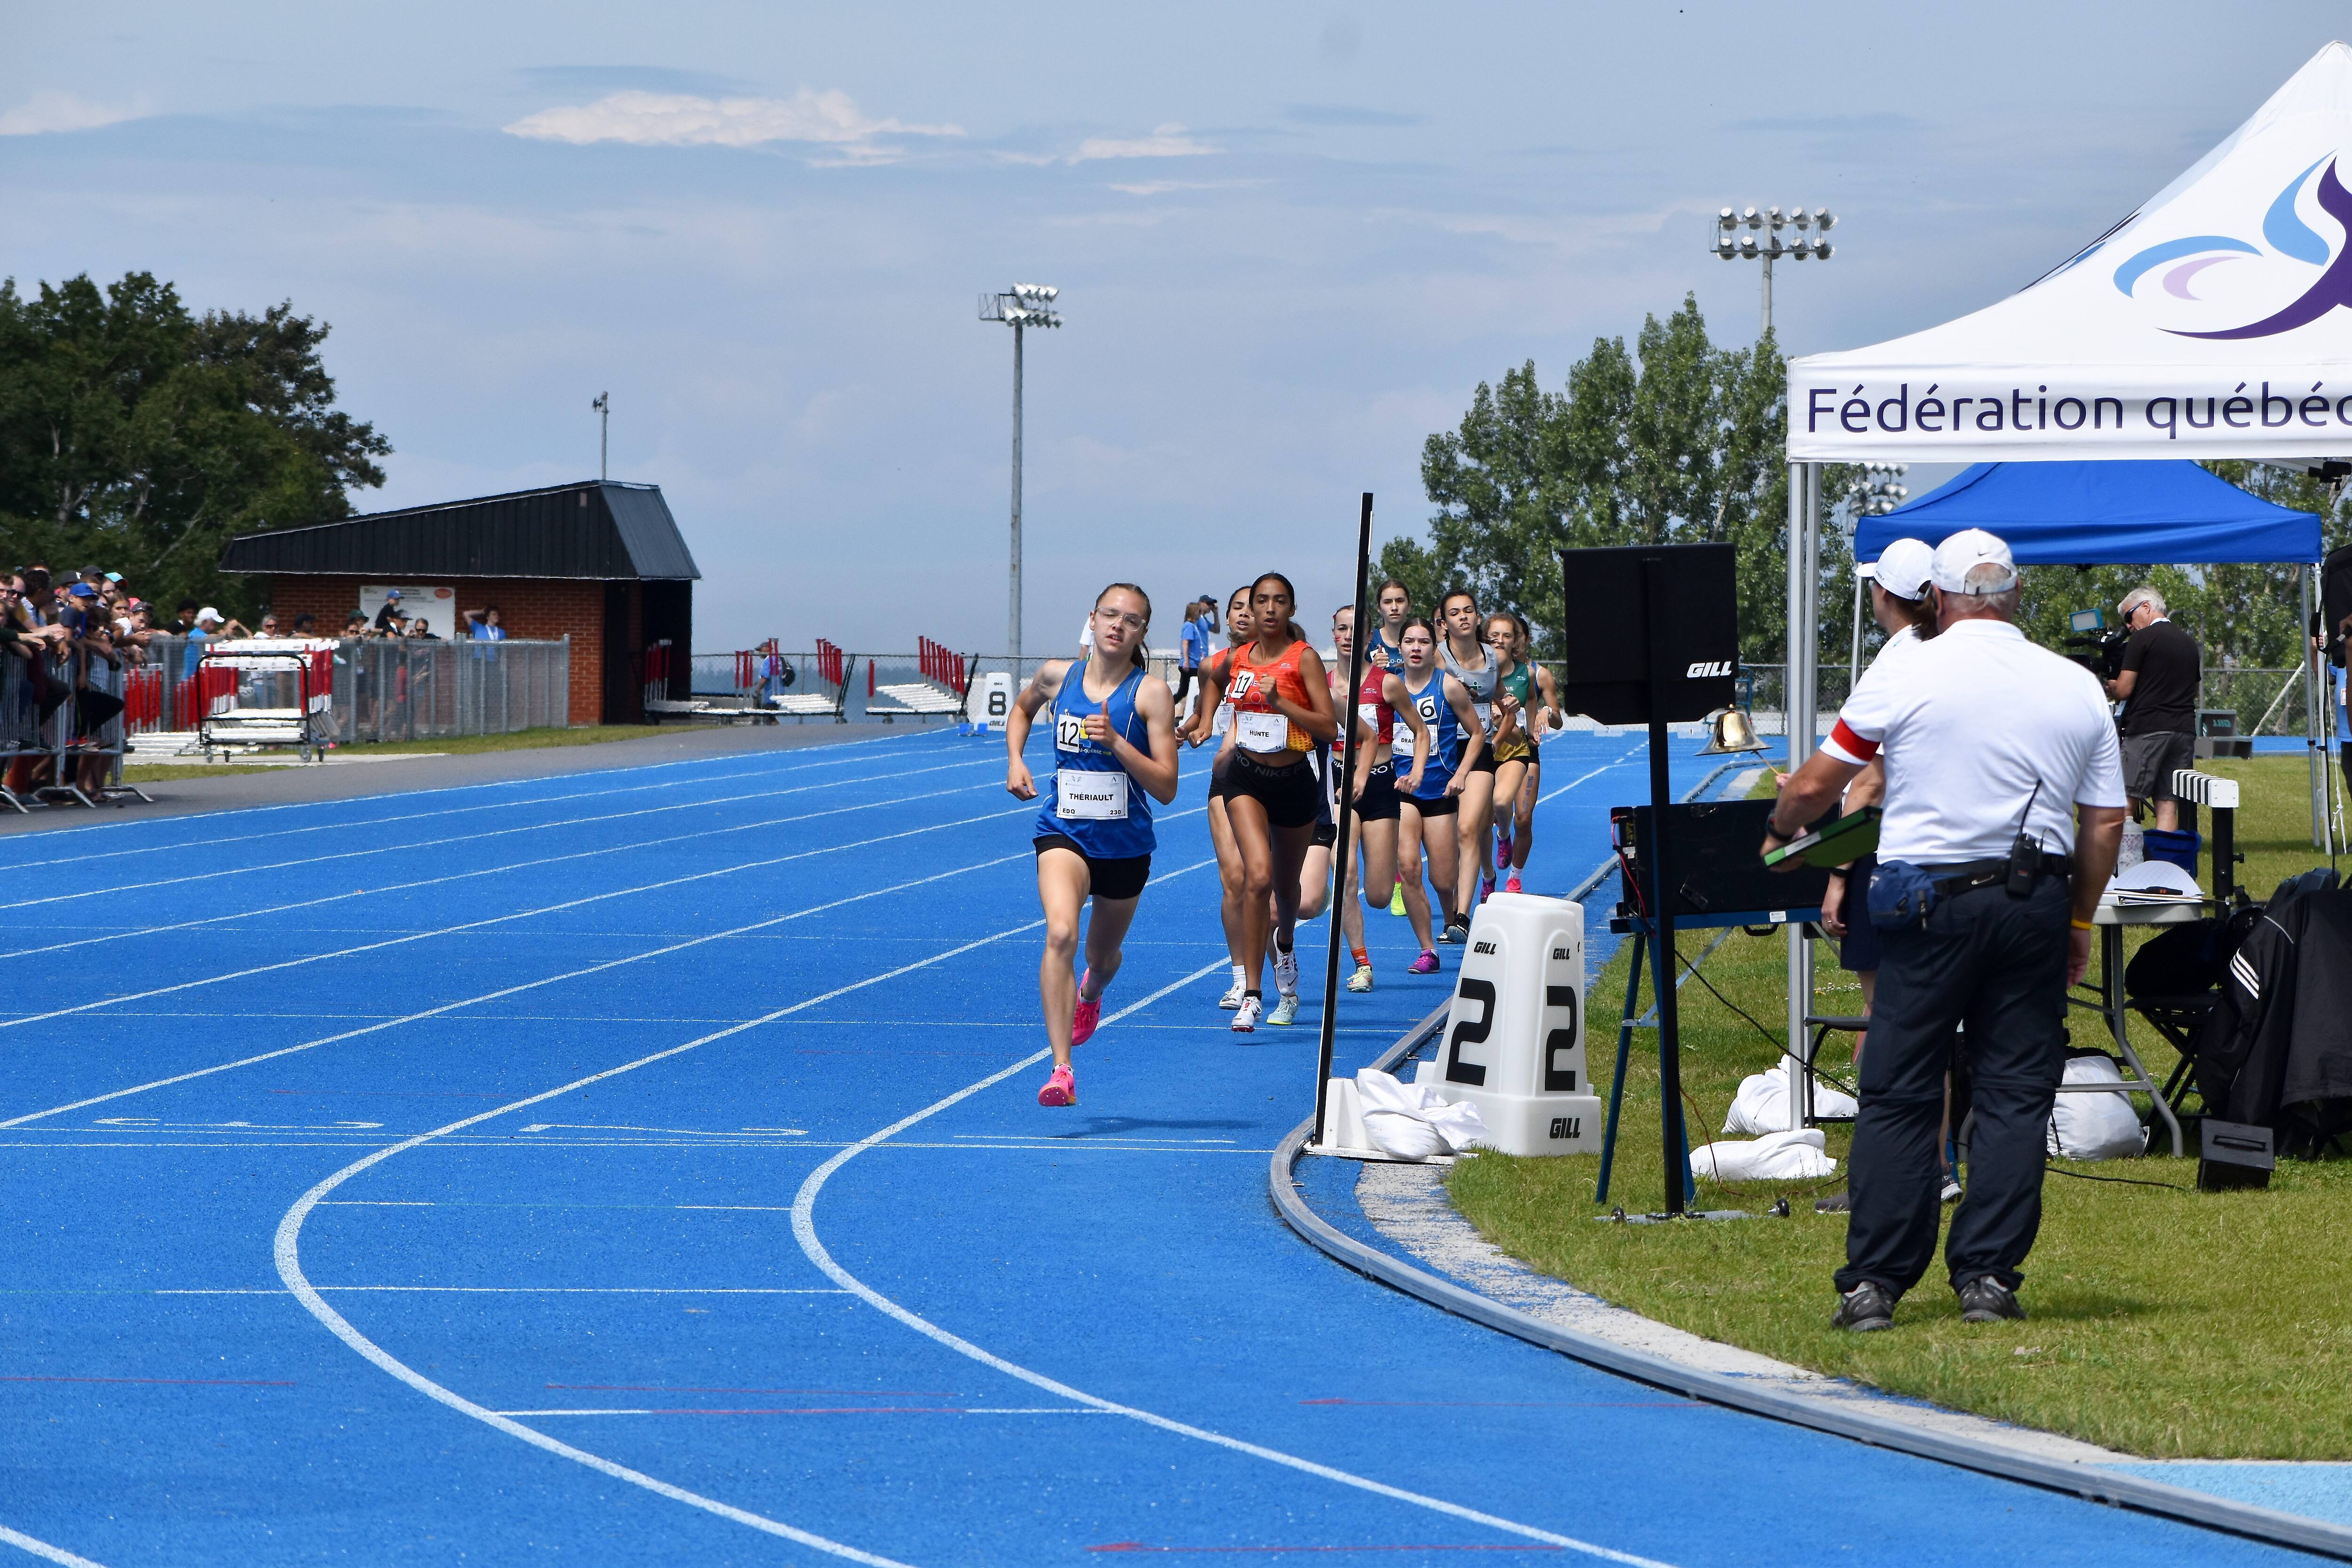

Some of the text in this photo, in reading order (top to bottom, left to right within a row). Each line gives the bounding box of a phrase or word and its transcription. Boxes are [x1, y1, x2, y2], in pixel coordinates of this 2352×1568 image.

[1808, 382, 2123, 433] Fédération
[1686, 661, 1732, 678] GILL
[1234, 674, 1251, 694] 11
[988, 691, 1006, 715] 8
[1420, 699, 1435, 718] 6
[1059, 721, 1079, 747] 12
[1255, 766, 1291, 778] NIKE
[1069, 792, 1114, 801] THÉRIAULT
[1473, 941, 1497, 955] GILL
[1552, 947, 1570, 960] GILL
[1446, 978, 1496, 1086] 2
[1544, 986, 1577, 1091] 2
[1549, 1117, 1581, 1139] GILL
